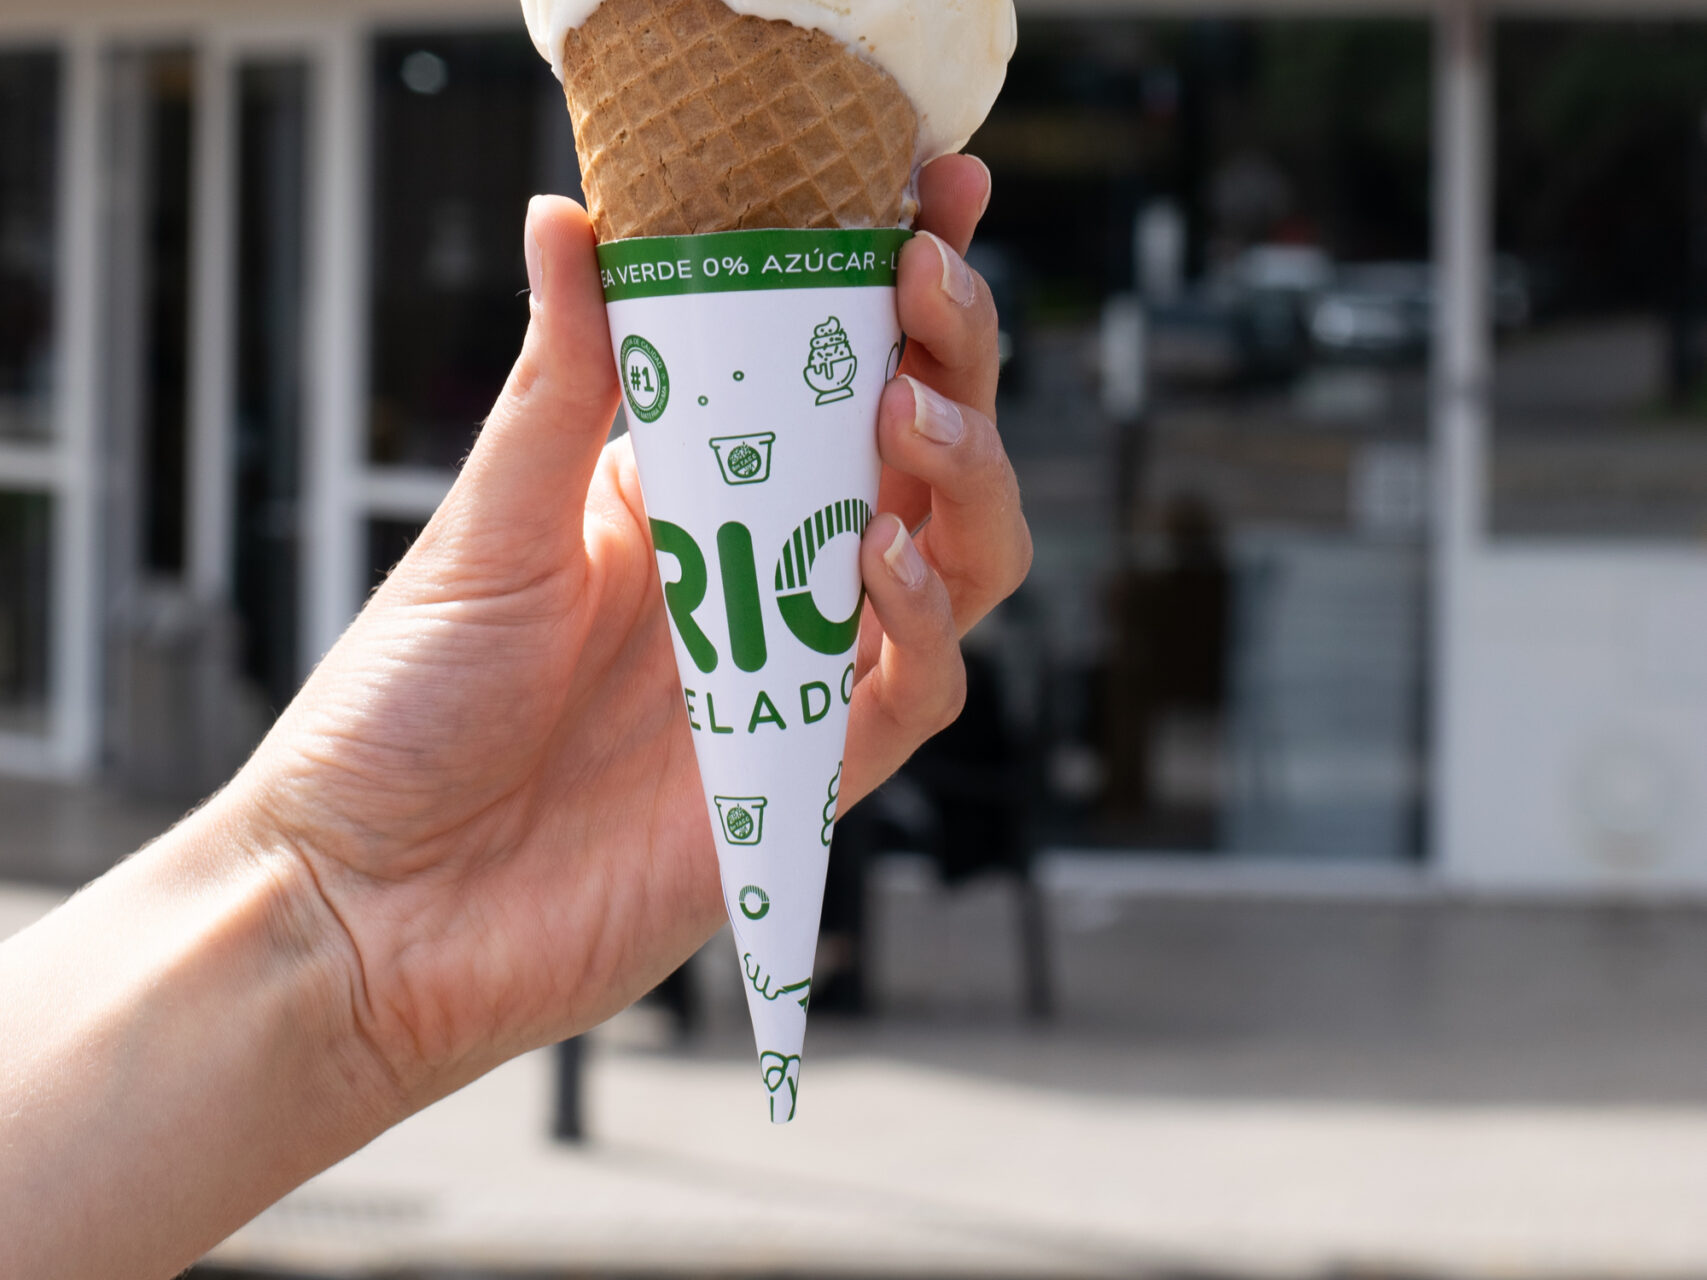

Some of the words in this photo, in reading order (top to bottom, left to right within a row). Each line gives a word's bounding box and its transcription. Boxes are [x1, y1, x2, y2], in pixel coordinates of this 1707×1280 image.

[616, 259, 693, 285] VERDE
[702, 255, 750, 277] 0%
[761, 247, 876, 274] AZÚCAR
[630, 365, 655, 393] #1
[648, 498, 873, 674] RIO
